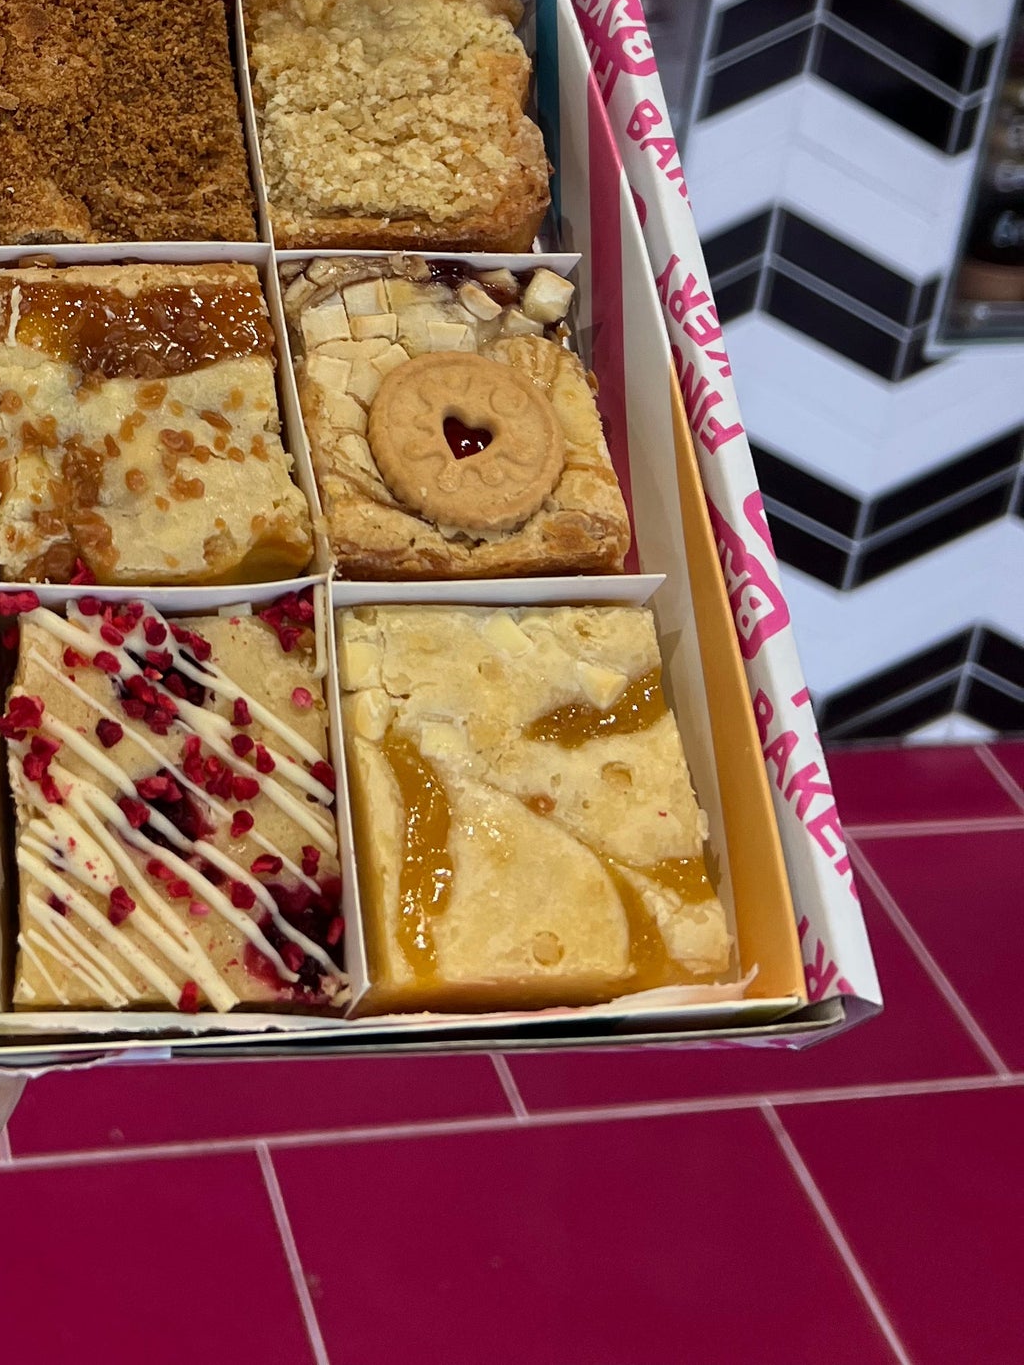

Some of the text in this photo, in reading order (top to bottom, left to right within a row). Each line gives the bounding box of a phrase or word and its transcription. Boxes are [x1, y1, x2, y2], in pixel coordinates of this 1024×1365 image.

[655, 253, 733, 378] ERY
[672, 344, 745, 456] FIN
[752, 687, 859, 902] BAKE
